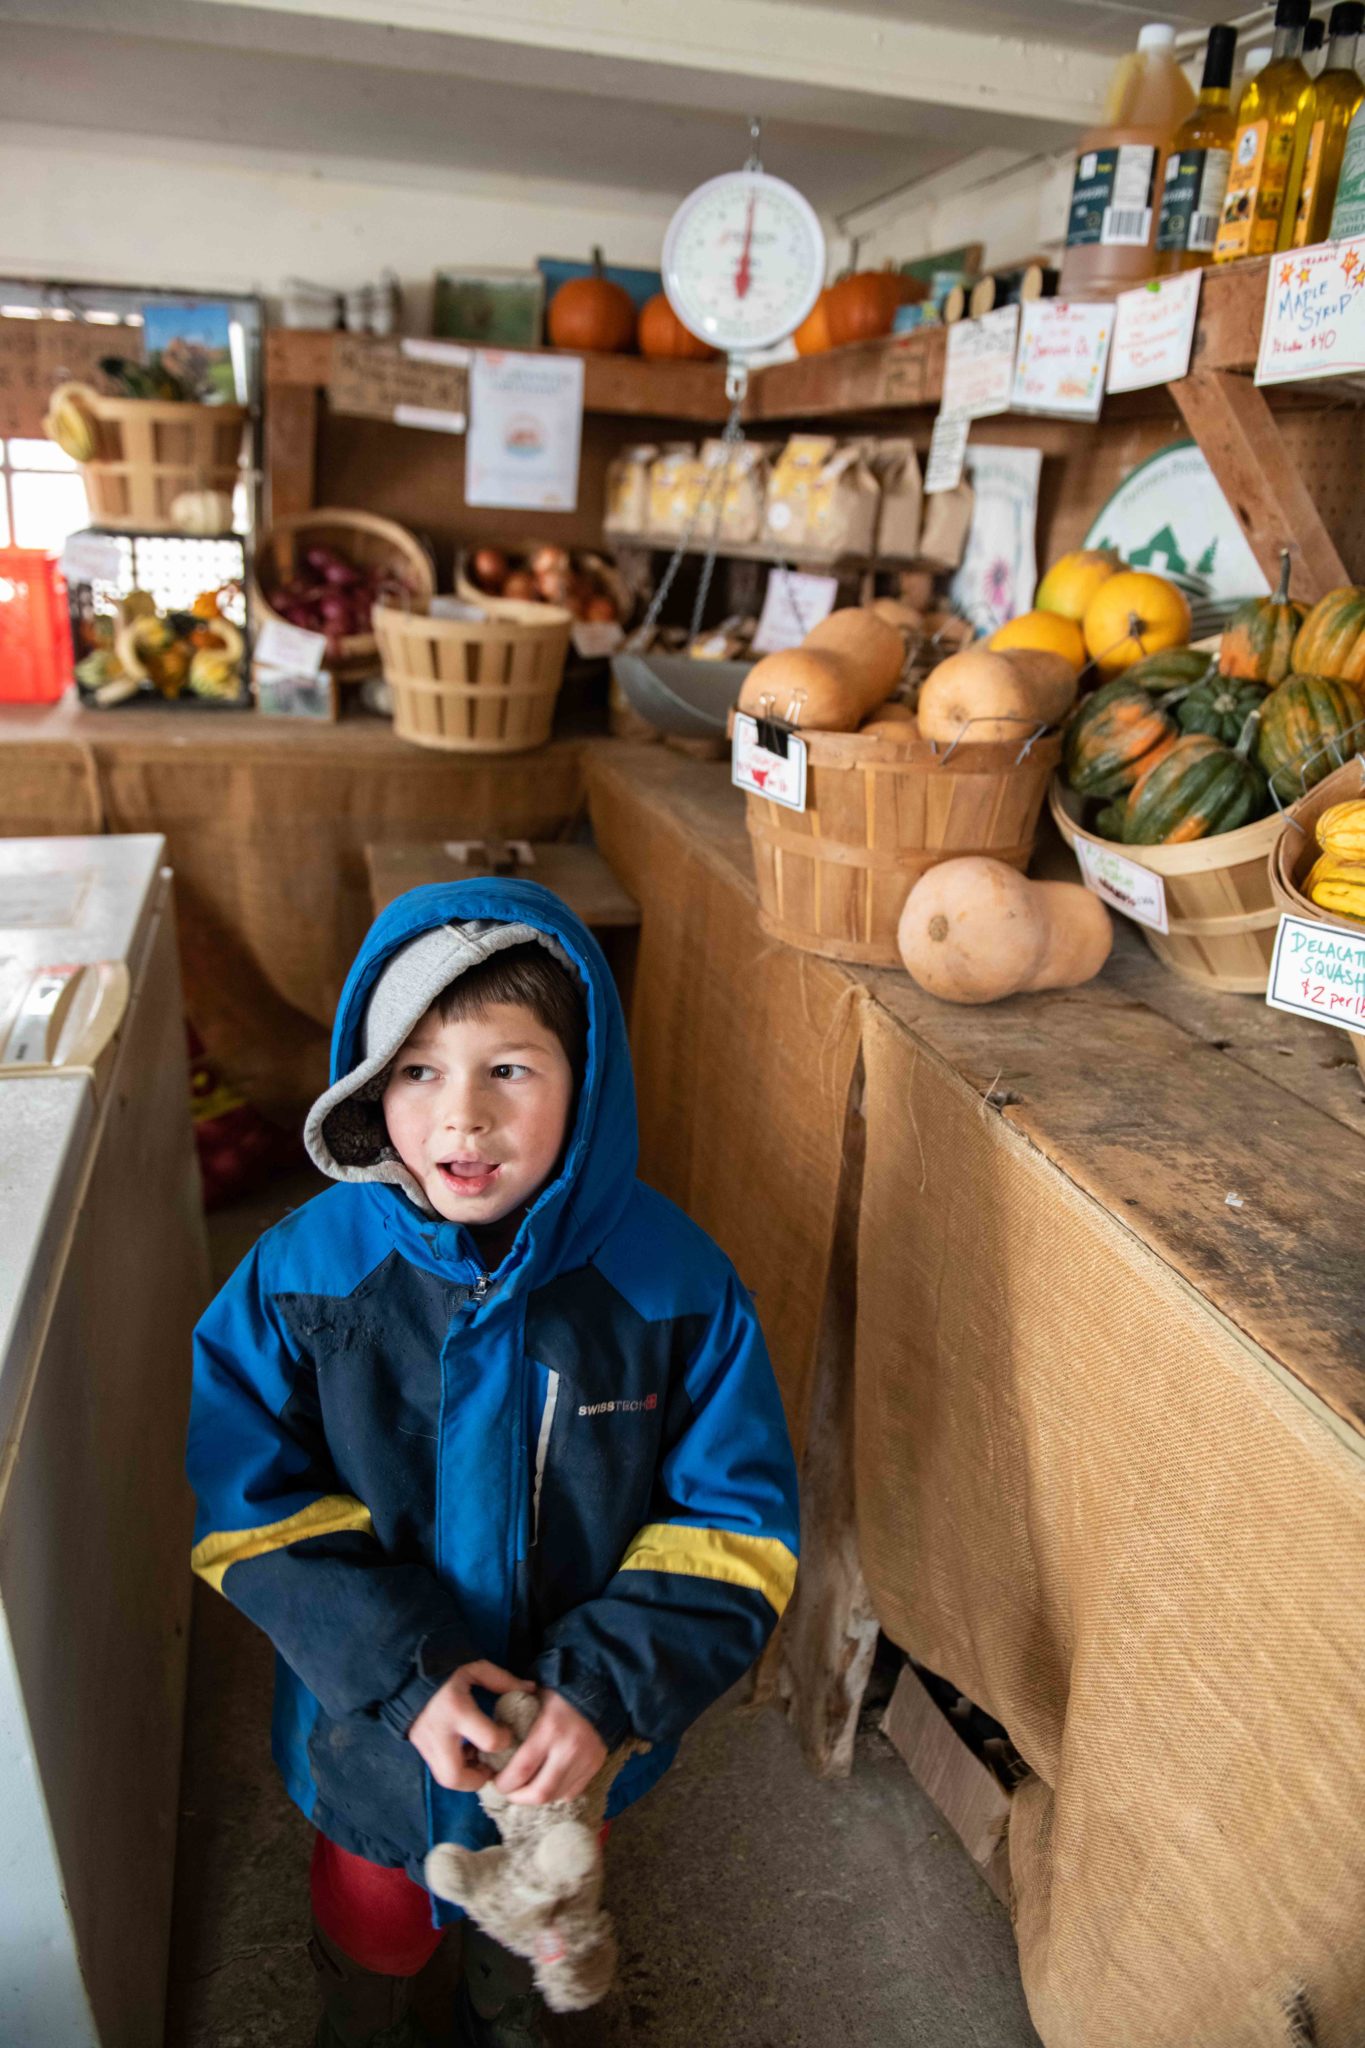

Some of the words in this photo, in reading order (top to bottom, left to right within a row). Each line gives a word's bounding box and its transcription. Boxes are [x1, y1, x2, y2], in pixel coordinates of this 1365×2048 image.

[1278, 280, 1328, 321] MAPLE
[1298, 293, 1352, 333] SYRUP
[1311, 329, 1337, 350] $40
[1300, 956, 1365, 996] SQUASH
[1301, 978, 1325, 1004] $2
[1329, 992, 1353, 1009] per
[578, 1399, 648, 1417] SWISSTECH
